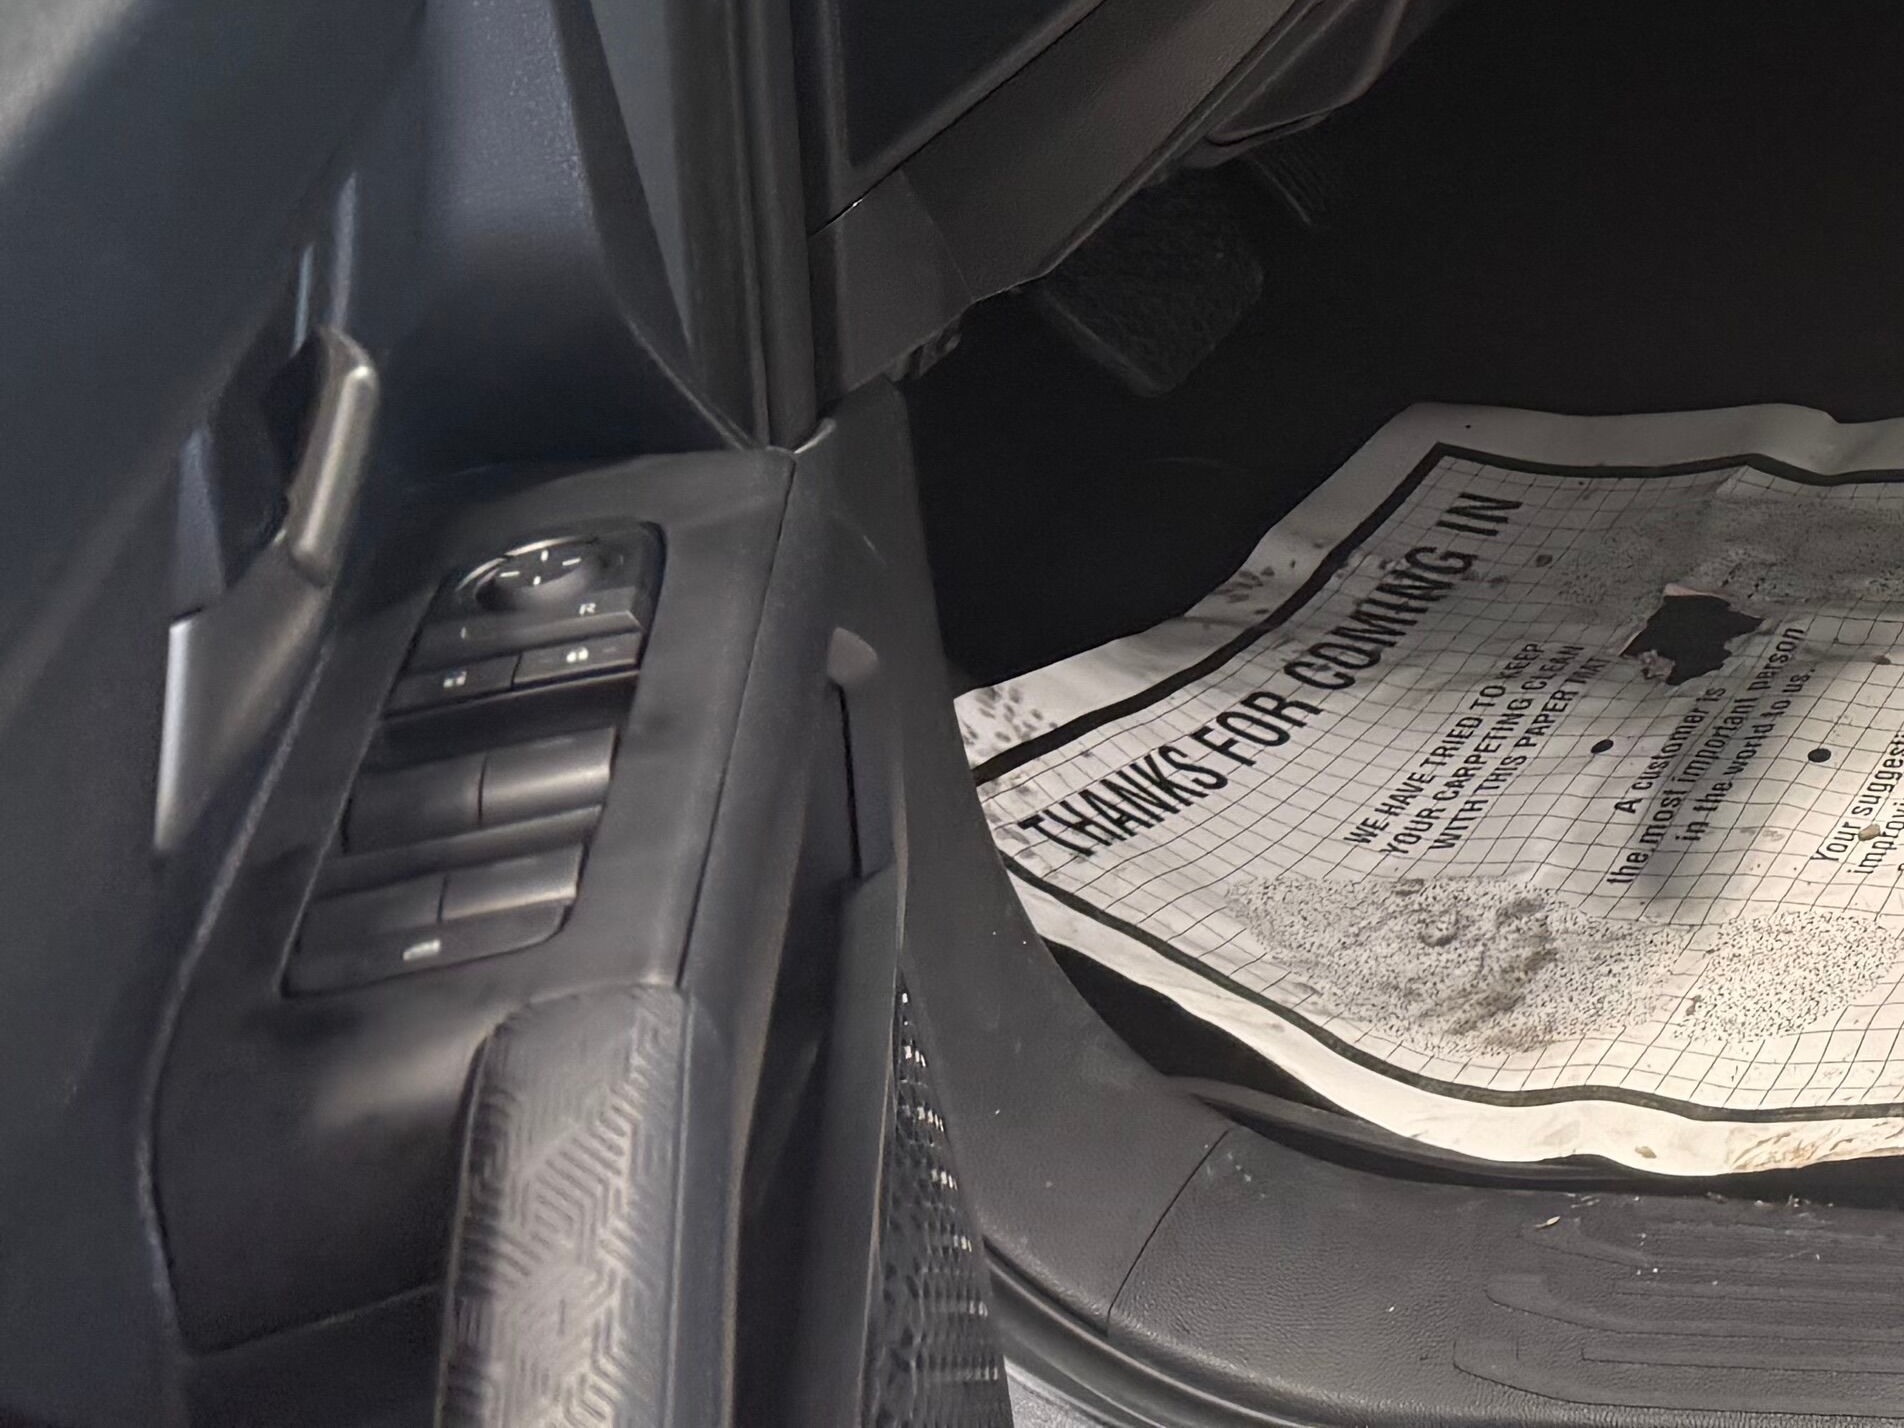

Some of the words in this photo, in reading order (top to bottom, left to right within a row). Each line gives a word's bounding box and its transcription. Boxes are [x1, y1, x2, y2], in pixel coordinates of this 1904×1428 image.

[1017, 745, 1229, 857] THANKS
[1188, 690, 1328, 768] FOR
[1284, 546, 1479, 691] COMING
[1437, 491, 1523, 536] IN
[1344, 809, 1390, 847] WE
[1376, 766, 1435, 824] HAVE
[1421, 715, 1473, 774] TRIED
[1470, 683, 1506, 715] TO
[1496, 643, 1545, 680] KEEP
[1382, 802, 1447, 857] YOUR
[1433, 697, 1533, 807] CARPETING
[1521, 645, 1585, 691] CLEAN
[1607, 849, 1650, 886] the
[1642, 786, 1688, 854] most
[1679, 694, 1758, 790] important
[1747, 626, 1805, 705] person
[1614, 796, 1643, 815] A
[1631, 699, 1709, 793] customer
[1676, 819, 1709, 843] in
[1695, 778, 1734, 823] the
[1724, 719, 1774, 785] world
[1762, 698, 1791, 726] to
[1783, 666, 1817, 704] us.
[1428, 796, 1490, 852] WITH
[1476, 752, 1528, 799] THIS
[1514, 689, 1579, 748] PAPER
[1810, 821, 1861, 862] Your
